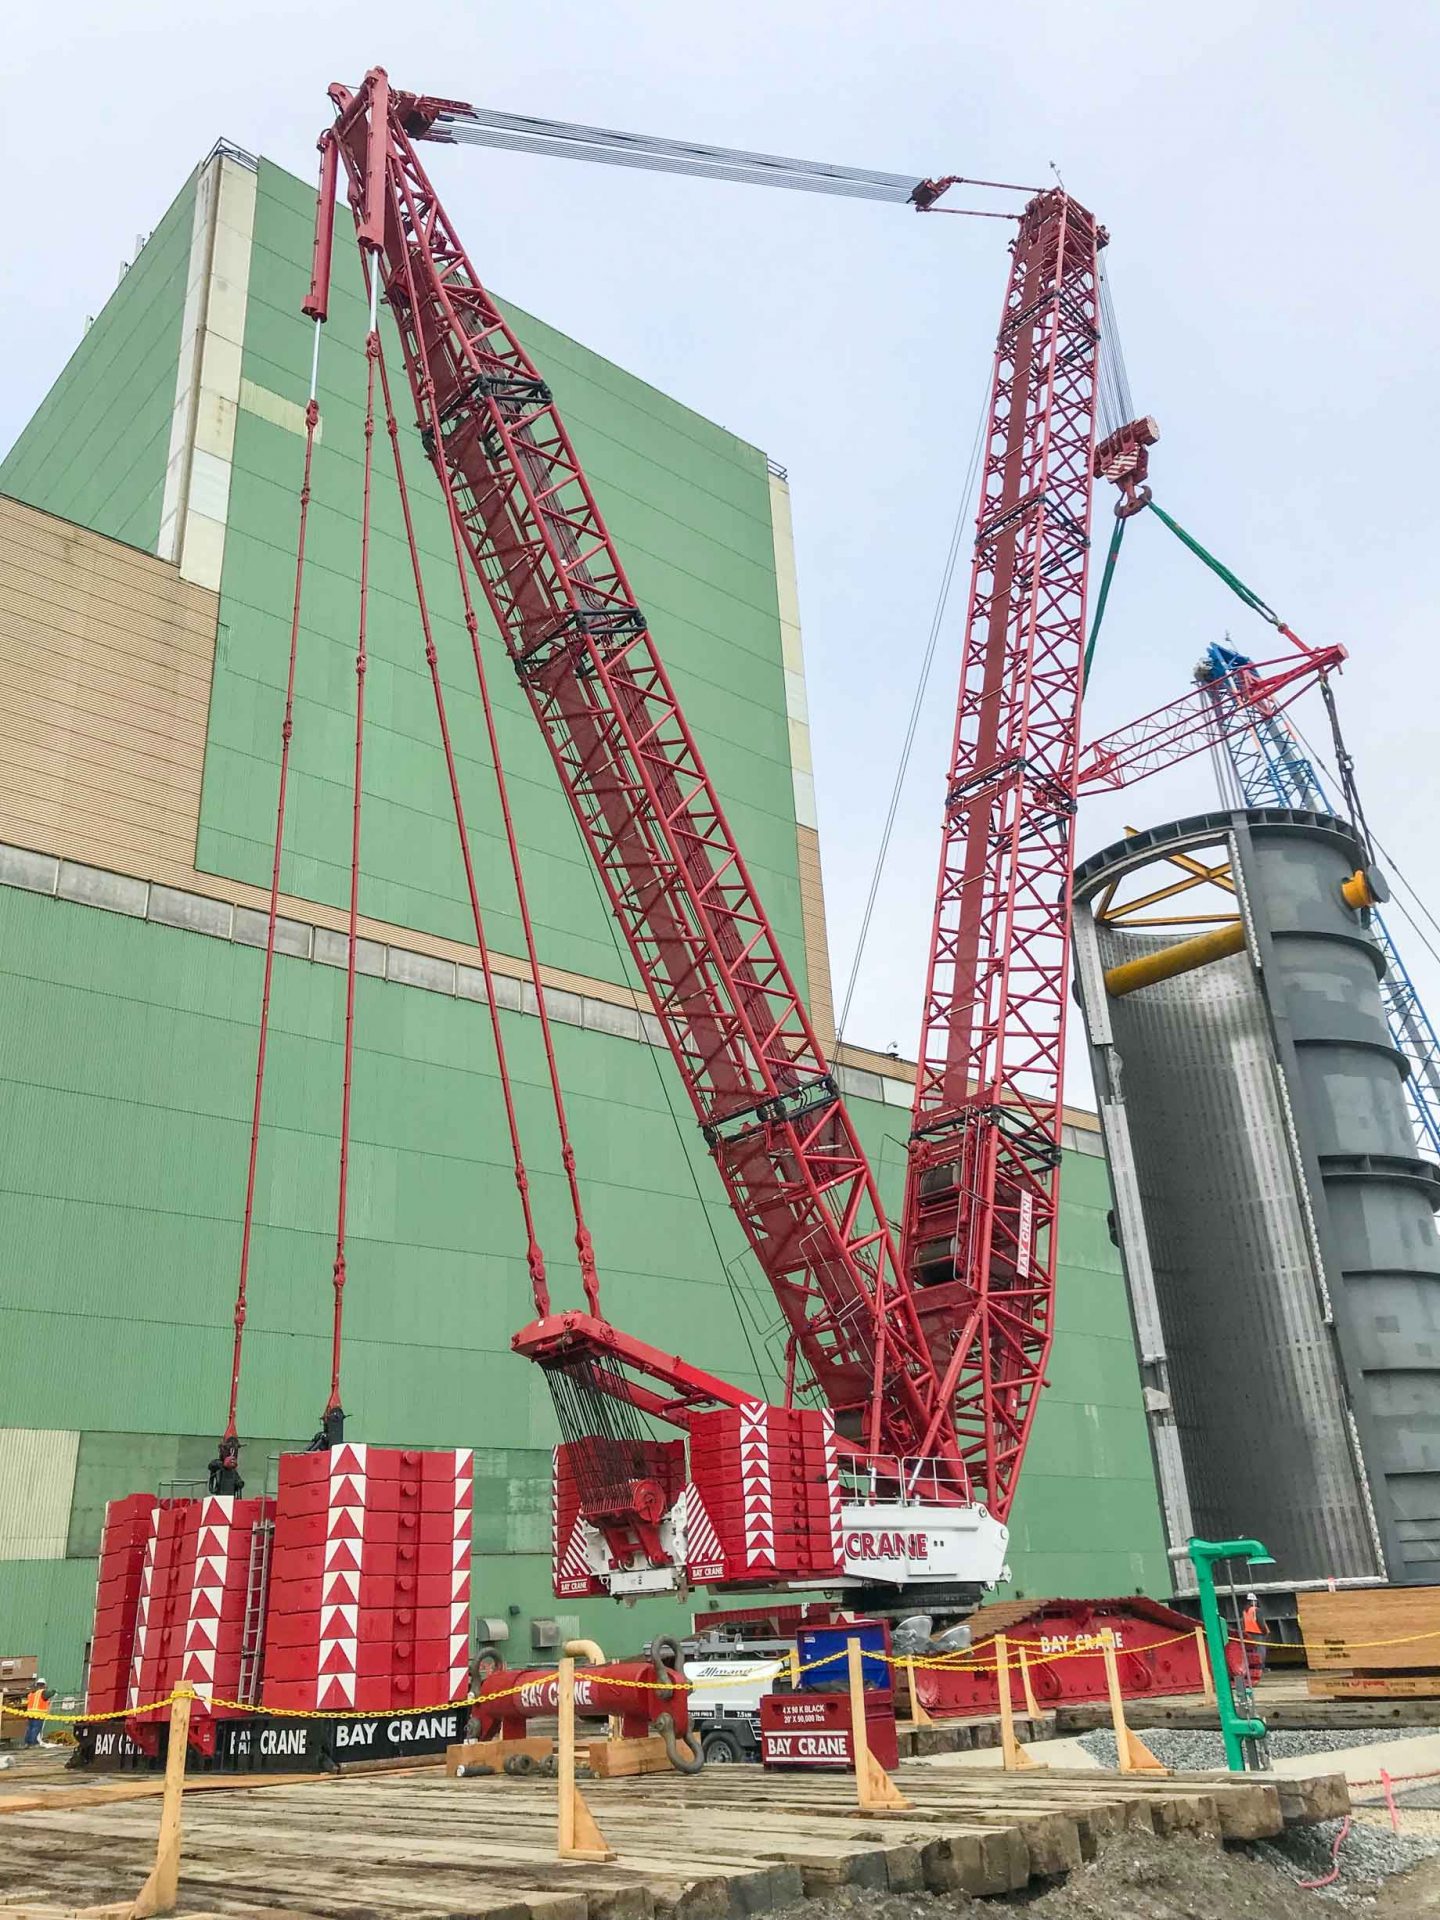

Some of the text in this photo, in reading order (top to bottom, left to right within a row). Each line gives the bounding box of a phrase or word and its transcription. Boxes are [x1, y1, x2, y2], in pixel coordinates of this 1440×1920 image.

[845, 1533, 928, 1560] CRANE
[704, 1566, 723, 1576] CRANE
[1041, 1636, 1068, 1653] BAY
[548, 1681, 592, 1706] CNE
[804, 1704, 825, 1713] BLACK
[260, 1729, 307, 1754] CRANE
[336, 1716, 457, 1747] BAY CRANE
[95, 1734, 116, 1754] BAY
[767, 1737, 847, 1755] BAY CRANE
